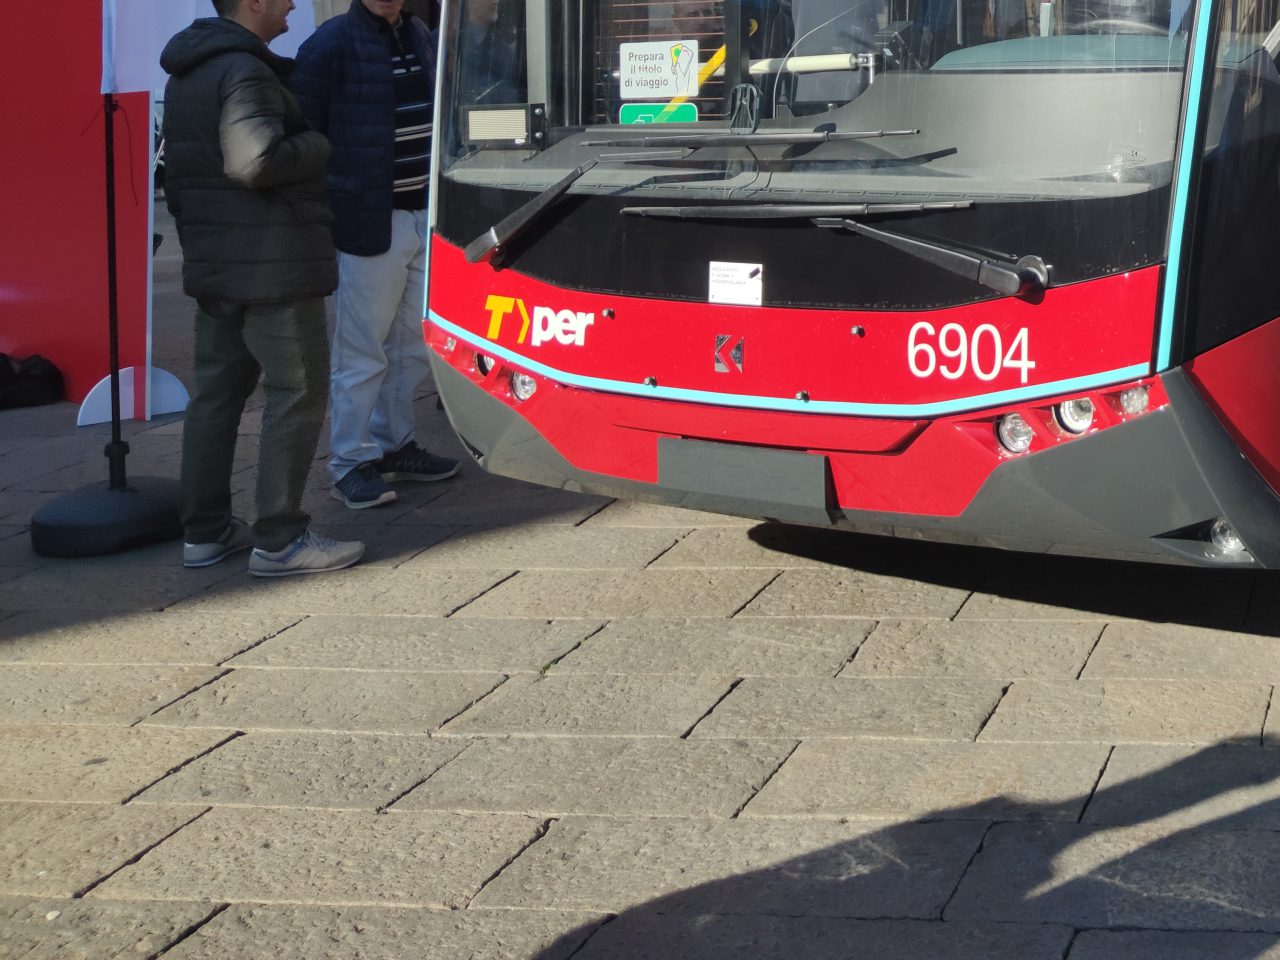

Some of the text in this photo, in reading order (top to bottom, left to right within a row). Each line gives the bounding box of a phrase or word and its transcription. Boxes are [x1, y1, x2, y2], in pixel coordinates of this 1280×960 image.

[628, 52, 664, 63] Prepara
[630, 64, 663, 75] il titolo
[624, 77, 669, 89] di viaggio
[907, 321, 1036, 384] 6904
